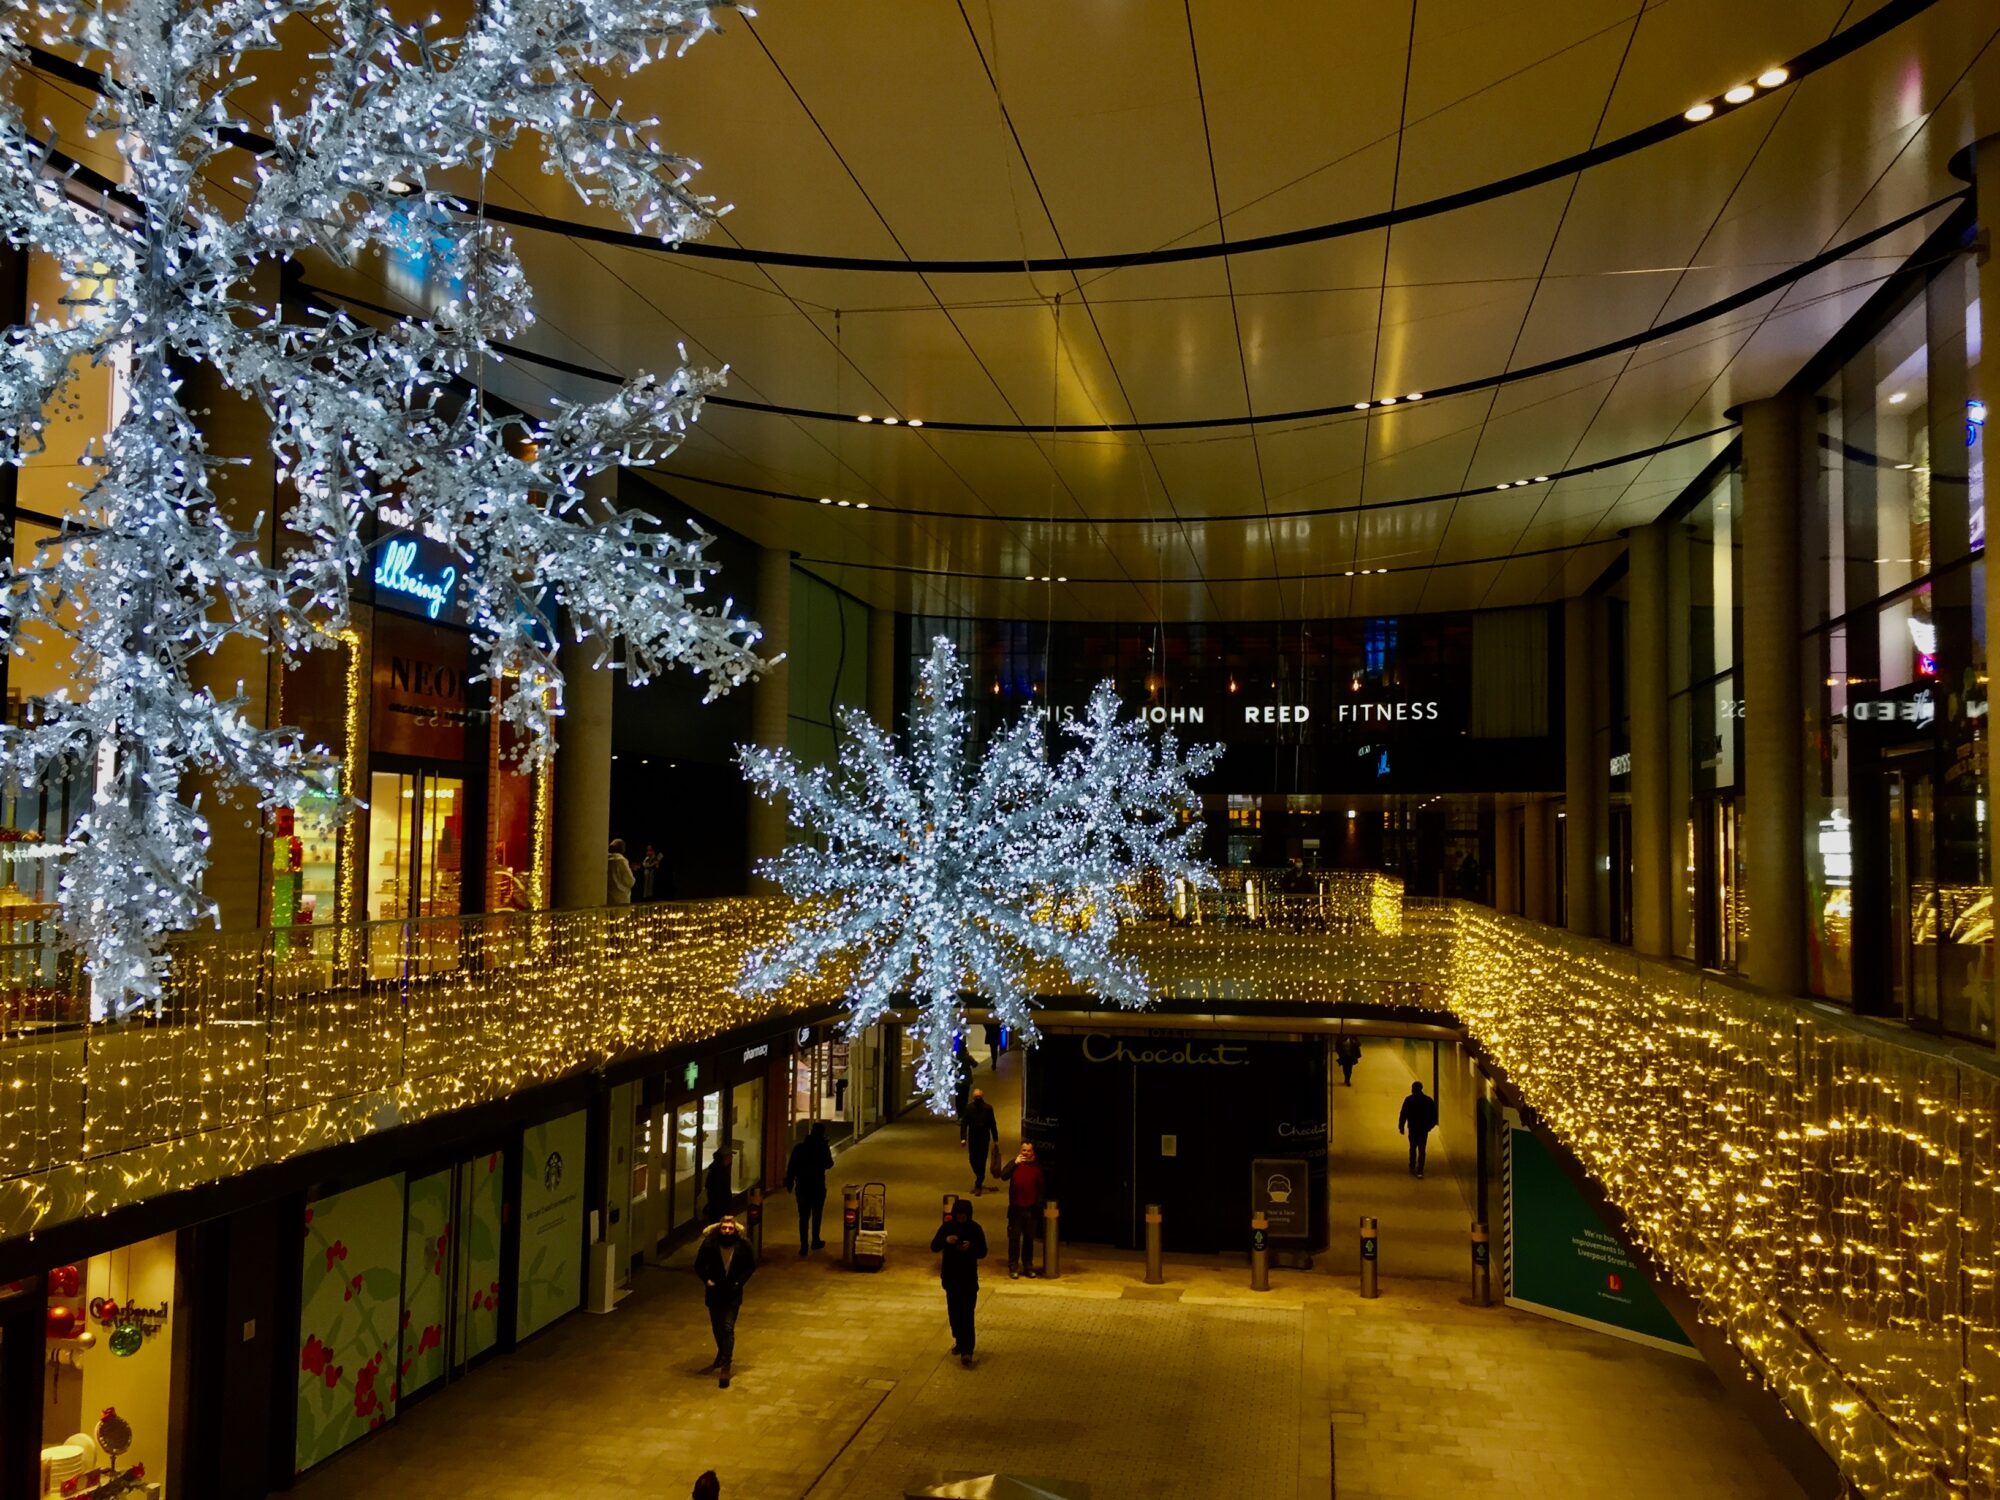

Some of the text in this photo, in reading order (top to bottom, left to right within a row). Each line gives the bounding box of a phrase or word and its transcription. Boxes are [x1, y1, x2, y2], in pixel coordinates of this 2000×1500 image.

[1139, 706, 1205, 724] JOHN
[1244, 705, 1310, 724] REED
[1338, 702, 1439, 723] FITNESS
[743, 1043, 769, 1064] pharmacy
